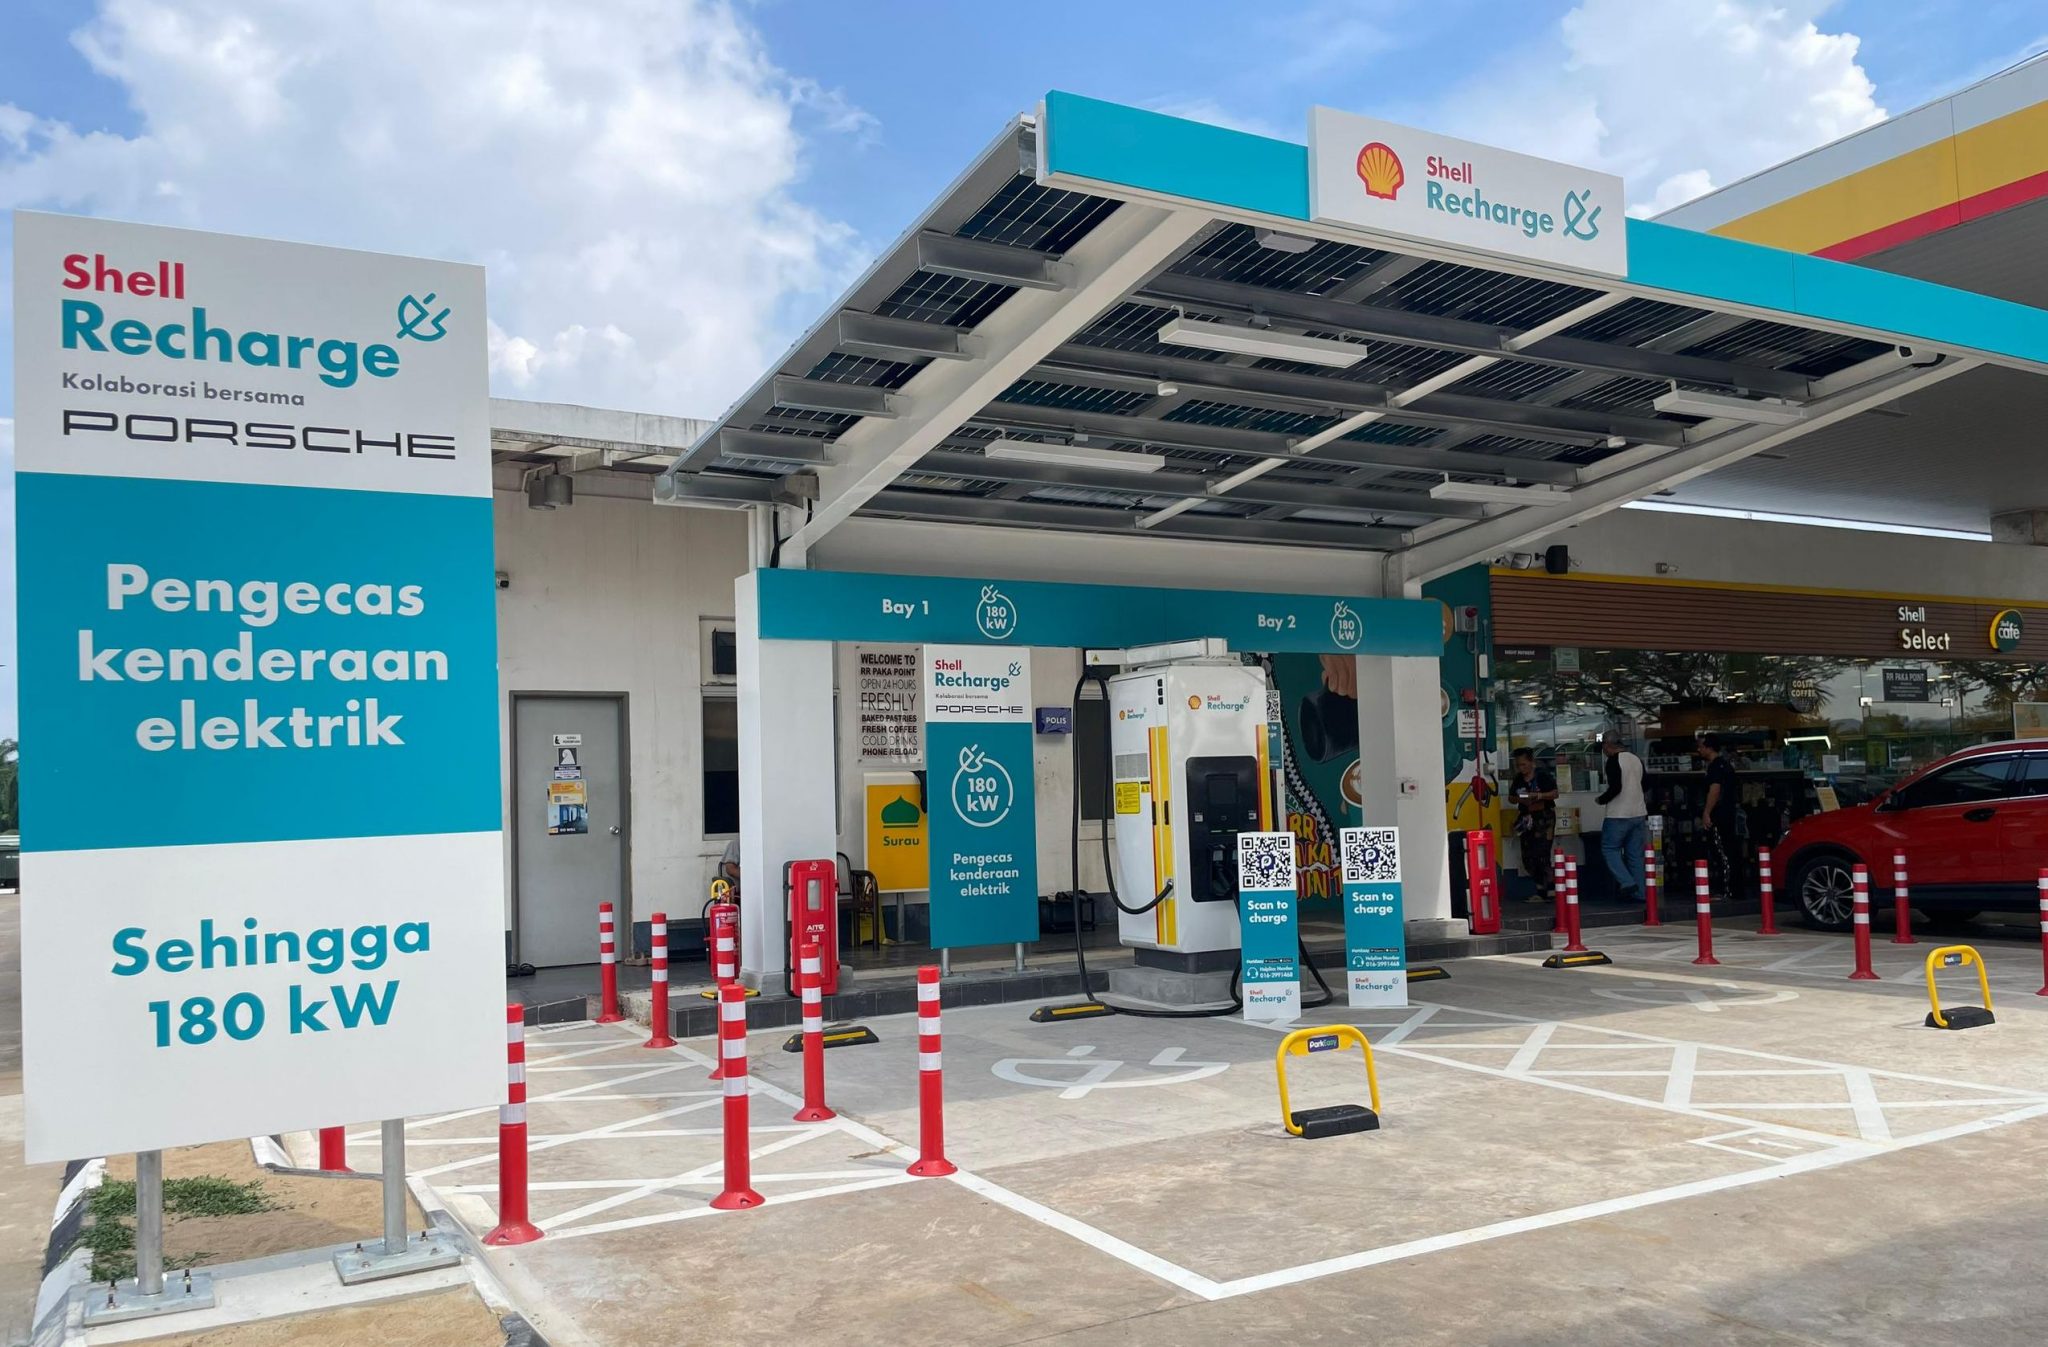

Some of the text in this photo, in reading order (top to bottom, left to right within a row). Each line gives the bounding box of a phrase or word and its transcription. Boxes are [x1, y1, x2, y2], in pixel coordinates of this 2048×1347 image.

[1426, 155, 1473, 184] Shell
[1426, 180, 1554, 238] Recharge
[62, 253, 186, 300] Shell
[61, 298, 401, 389] Recharge
[62, 372, 305, 407] Kolaborasi bersama
[63, 409, 456, 460] PORSCHE
[106, 563, 425, 627] Pengecas
[882, 598, 929, 619] Bay 1
[986, 606, 1007, 617] 180
[1898, 606, 1925, 622] Shell
[986, 616, 1007, 630] kW
[1257, 614, 1296, 632] Bay 2
[1338, 620, 1355, 630] 180
[1338, 630, 1355, 641] kW
[1998, 622, 2020, 640] café
[1901, 628, 1950, 651] Select
[78, 630, 449, 682] kenderaan
[860, 653, 916, 665] WELCOME TO
[860, 667, 916, 676] RR PAKA POINT
[935, 659, 962, 671] Shell
[861, 679, 917, 690] OPEN 24 HOURS
[935, 672, 1010, 692] Recharge
[861, 692, 917, 711] FRESHLY
[1207, 702, 1245, 711] Recharge
[935, 705, 1023, 714] PORSCHE
[135, 698, 406, 751] elektrik
[861, 714, 917, 723] BAKED PASTRIES
[1045, 716, 1067, 725] POLIS
[861, 725, 917, 734] FRESH COFFEE
[862, 735, 918, 746] COLD DRINKS
[862, 747, 918, 756] PHONE RELOAD
[967, 777, 997, 793] 180
[966, 794, 999, 812] kW
[883, 836, 920, 846] Surau
[953, 853, 1013, 866] Pengecas
[950, 867, 1019, 881] kenderaan
[960, 881, 1010, 896] elektrik
[1352, 892, 1394, 902] Scan to
[1247, 900, 1288, 910] Scan to
[1354, 903, 1394, 916] charge
[1249, 911, 1288, 925] charge
[111, 917, 430, 976] Sehingga
[1355, 982, 1393, 992] Recharge
[1249, 994, 1287, 1004] Recharge
[148, 980, 400, 1048] 180 kW
